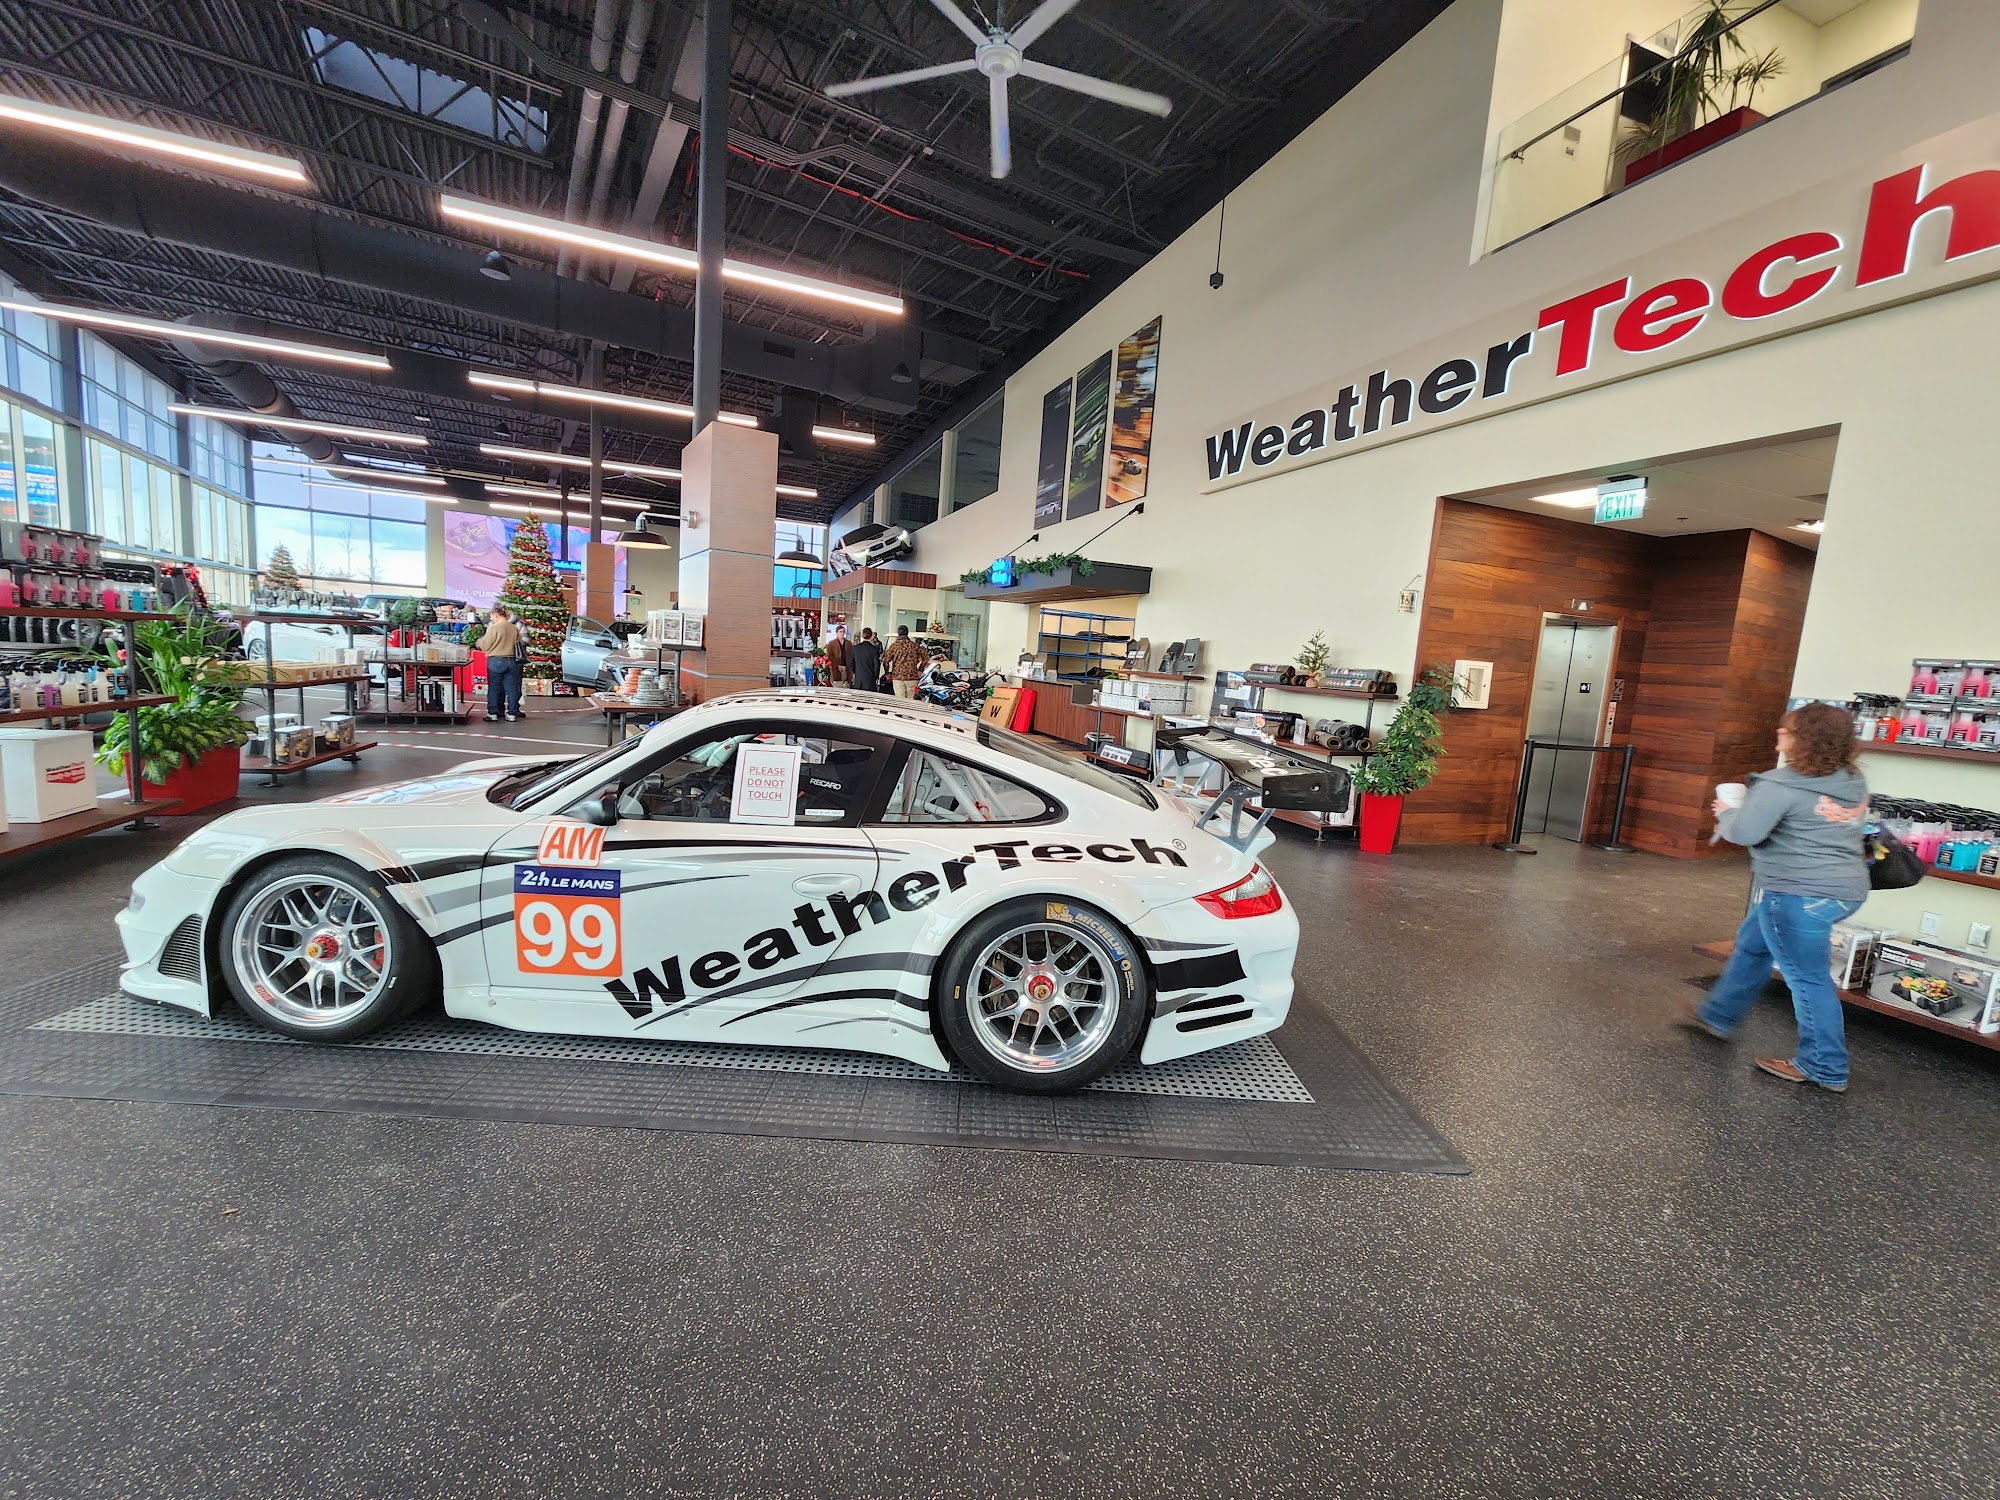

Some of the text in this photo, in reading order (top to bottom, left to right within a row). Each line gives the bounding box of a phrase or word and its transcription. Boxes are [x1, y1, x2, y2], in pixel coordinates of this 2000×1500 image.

[1205, 164, 2000, 482] WeatherTech
[1604, 494, 1638, 520] EXIT
[990, 705, 1002, 718] W
[749, 766, 786, 775] PLEASE
[747, 778, 786, 788] DO NOT
[809, 777, 842, 791] RECARO
[748, 790, 782, 799] TOUCH
[542, 826, 605, 861] AM
[551, 877, 570, 888] LE
[571, 879, 614, 890] MANS
[519, 901, 617, 970] 99
[1074, 912, 1125, 956] MICHELIN
